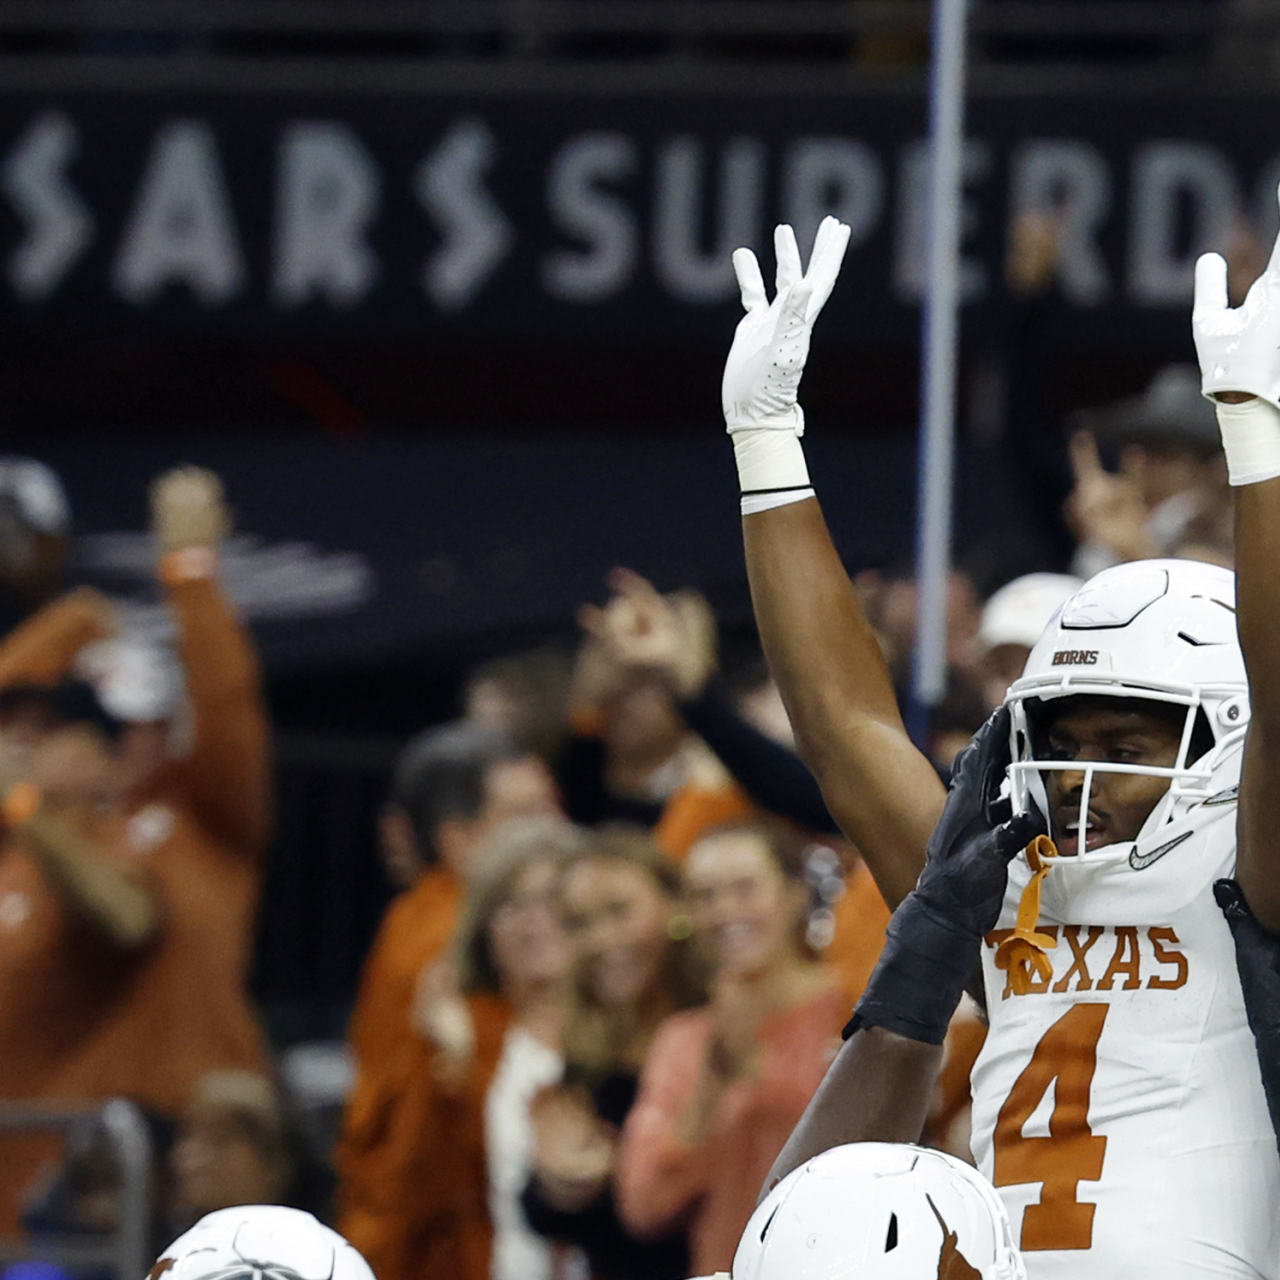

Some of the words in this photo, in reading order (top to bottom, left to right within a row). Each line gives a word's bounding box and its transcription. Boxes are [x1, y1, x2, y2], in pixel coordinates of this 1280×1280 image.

[4, 111, 514, 309] SARS
[1051, 650, 1100, 667] HORNS
[993, 1002, 1110, 1252] 4
